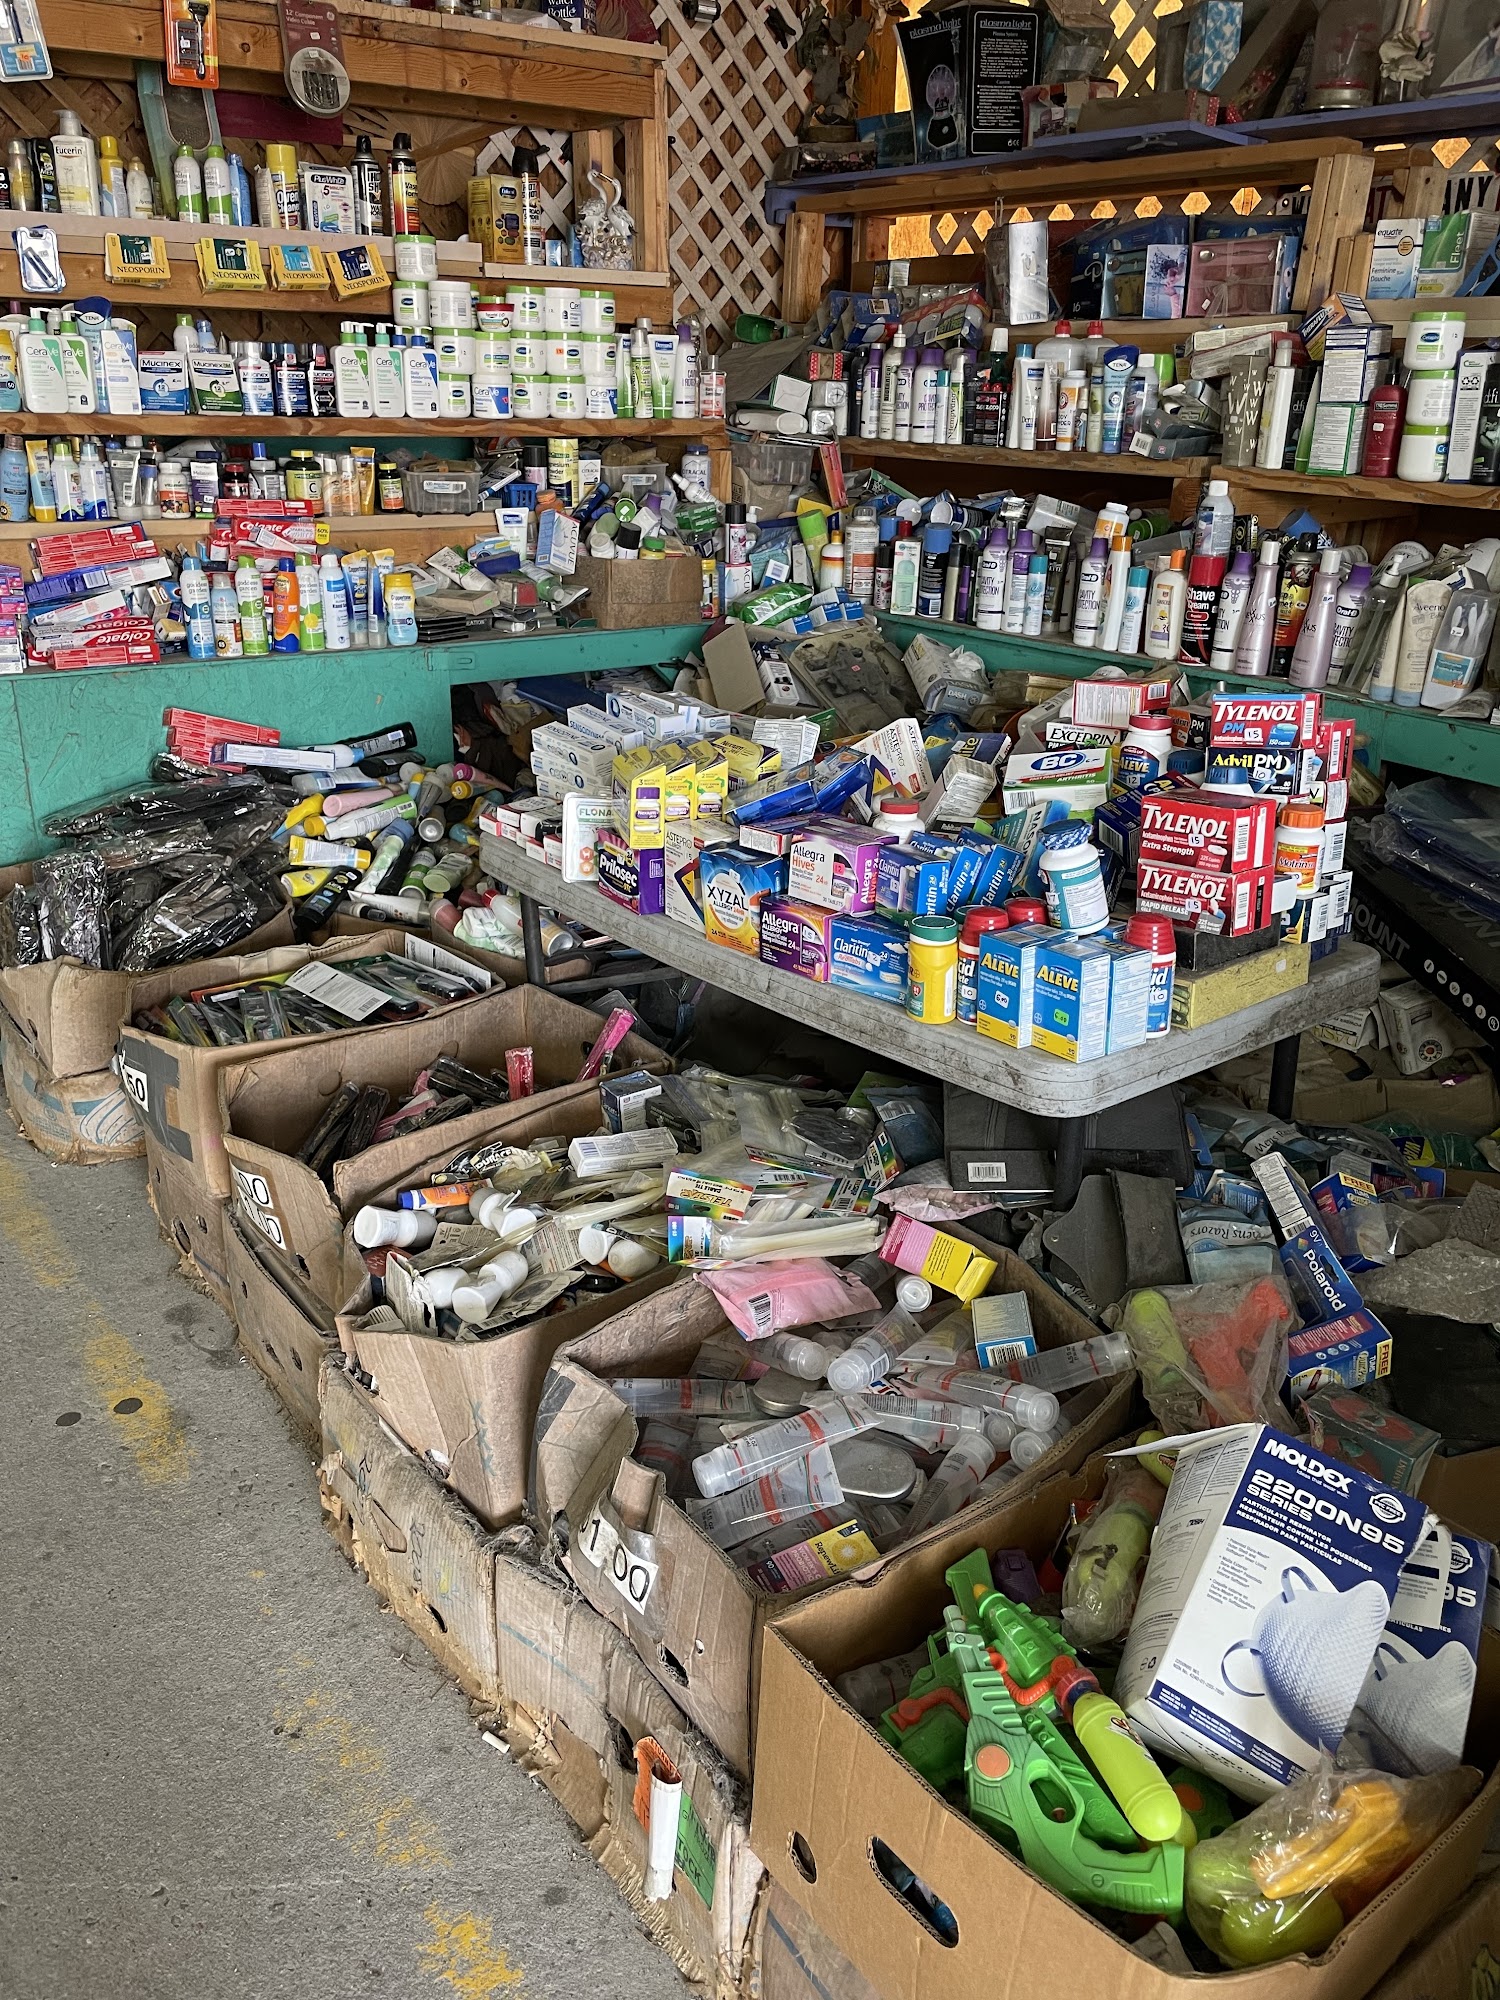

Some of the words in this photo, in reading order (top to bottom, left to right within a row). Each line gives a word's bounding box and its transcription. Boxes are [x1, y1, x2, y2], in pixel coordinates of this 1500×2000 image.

[548, 6, 576, 18] Bottle
[55, 146, 82, 155] Eucerin
[277, 190, 299, 203] Oven
[323, 186, 330, 196] 5
[1377, 229, 1402, 237] equate
[1450, 231, 1464, 264] Fleet
[117, 266, 165, 274] NEOSPORIN
[212, 271, 260, 280] NEOSPORIN
[343, 276, 385, 290] NEOSPORIN
[1303, 312, 1326, 337] THERAFLU
[26, 346, 59, 357] CeraVe
[104, 342, 133, 351] CeraVe
[142, 359, 181, 368] Mucinex
[193, 360, 223, 368] Mucinex
[340, 357, 368, 366] CeraVe
[376, 357, 400, 366] CeraVe
[409, 359, 436, 369] CeraVe
[474, 387, 499, 397] CeraVe
[590, 389, 615, 398] CeraVe
[309, 482, 317, 493] C
[239, 521, 284, 532] Colgate
[567, 520, 578, 566] ACUVUE
[1187, 587, 1215, 601] Shave
[1187, 602, 1209, 611] Cream
[1336, 606, 1358, 617] Oral-B
[1413, 602, 1445, 611] Aveeno
[86, 619, 148, 630] Colgate
[96, 631, 151, 644] Colgate
[948, 690, 967, 699] DASH
[1214, 701, 1297, 722] TYLENOL
[569, 721, 598, 739] SENSODYNE
[1191, 720, 1205, 731] PM
[1222, 722, 1245, 733] PM
[1050, 729, 1116, 746] EXCEDRIN
[1040, 754, 1077, 769] BC
[1119, 761, 1149, 772] ALEVE
[1212, 754, 1253, 768] Advil
[1254, 754, 1282, 769] PM
[1057, 773, 1096, 783] ARTHRITIS
[1128, 776, 1137, 784] 12
[579, 807, 612, 816] FLONA
[1143, 804, 1229, 840] TYLENOL
[666, 832, 692, 849] ASTEPRO
[1142, 840, 1161, 850] Extra
[1162, 844, 1194, 856] Strength
[793, 844, 825, 862] Allegra
[792, 856, 815, 871] Hives
[1279, 856, 1308, 868] Motrin
[600, 853, 638, 887] Prilosec
[860, 859, 872, 904] Allegra
[868, 871, 878, 903] Hives
[1141, 865, 1227, 901] TYLENOL
[707, 884, 749, 911] XYZAL
[927, 886, 938, 915] aritin
[1141, 900, 1160, 909] RAPID
[1161, 904, 1189, 916] RELEASE
[762, 911, 799, 934] Allegra
[834, 937, 868, 956] Claritin
[980, 952, 1020, 978] ALEVE
[1036, 965, 1079, 992] ALEVE
[1254, 1134, 1278, 1153] Mens
[476, 1149, 512, 1169] DURACE
[1344, 1175, 1373, 1191] FREE
[1353, 1189, 1370, 1199] TUMS
[1190, 1225, 1230, 1240] Razors
[1309, 1229, 1320, 1243] 9V
[1303, 1249, 1346, 1312] Polaroid
[1381, 1344, 1390, 1375] FREE
[1263, 1438, 1353, 1493] MOLDEX
[1246, 1484, 1313, 1522] SERIES
[1251, 1468, 1405, 1555] 2200N95
[1242, 1497, 1288, 1523] PARTICULATE
[1289, 1517, 1332, 1544] RESPIRATOR
[1236, 1510, 1279, 1535] RESPIRADOR
[1280, 1531, 1299, 1544] PARA
[1300, 1539, 1343, 1566] PARTICULAS
[1239, 1503, 1285, 1530] RESPIRATEUR
[1286, 1525, 1315, 1542] CONTRE
[1315, 1538, 1329, 1550] LES
[1330, 1546, 1373, 1573] POUSSIÈRES
[766, 1560, 775, 1569] 90
[815, 1541, 841, 1575] RenewLi
